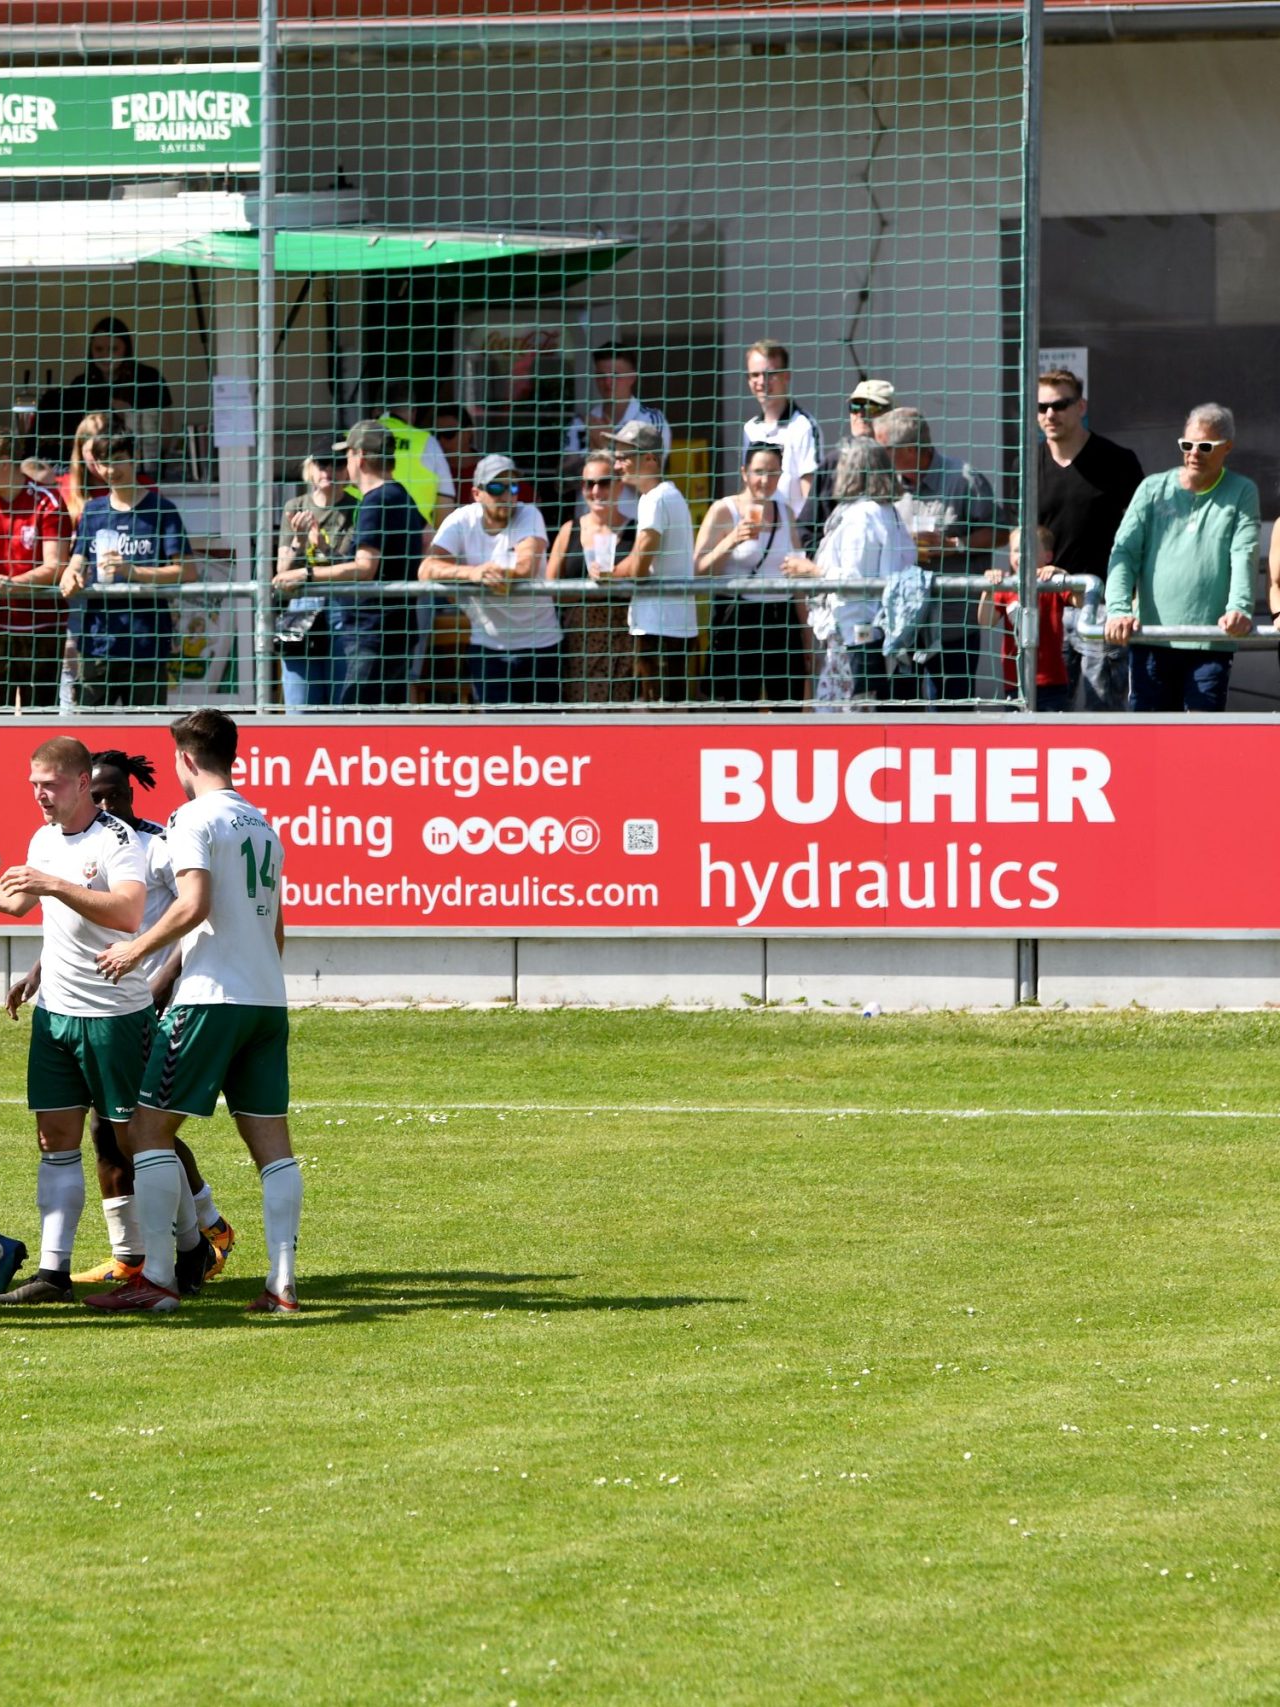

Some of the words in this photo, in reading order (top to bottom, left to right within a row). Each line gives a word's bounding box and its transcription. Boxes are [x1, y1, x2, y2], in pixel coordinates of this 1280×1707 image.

[111, 90, 252, 130] ERDINGER
[134, 121, 231, 142] BRAUHAUS
[160, 143, 206, 154] BAYERN
[304, 746, 591, 797] Arbeitgeber
[700, 747, 1116, 824] BUCHER
[241, 836, 276, 898] 14
[699, 842, 1060, 926] hydraulics
